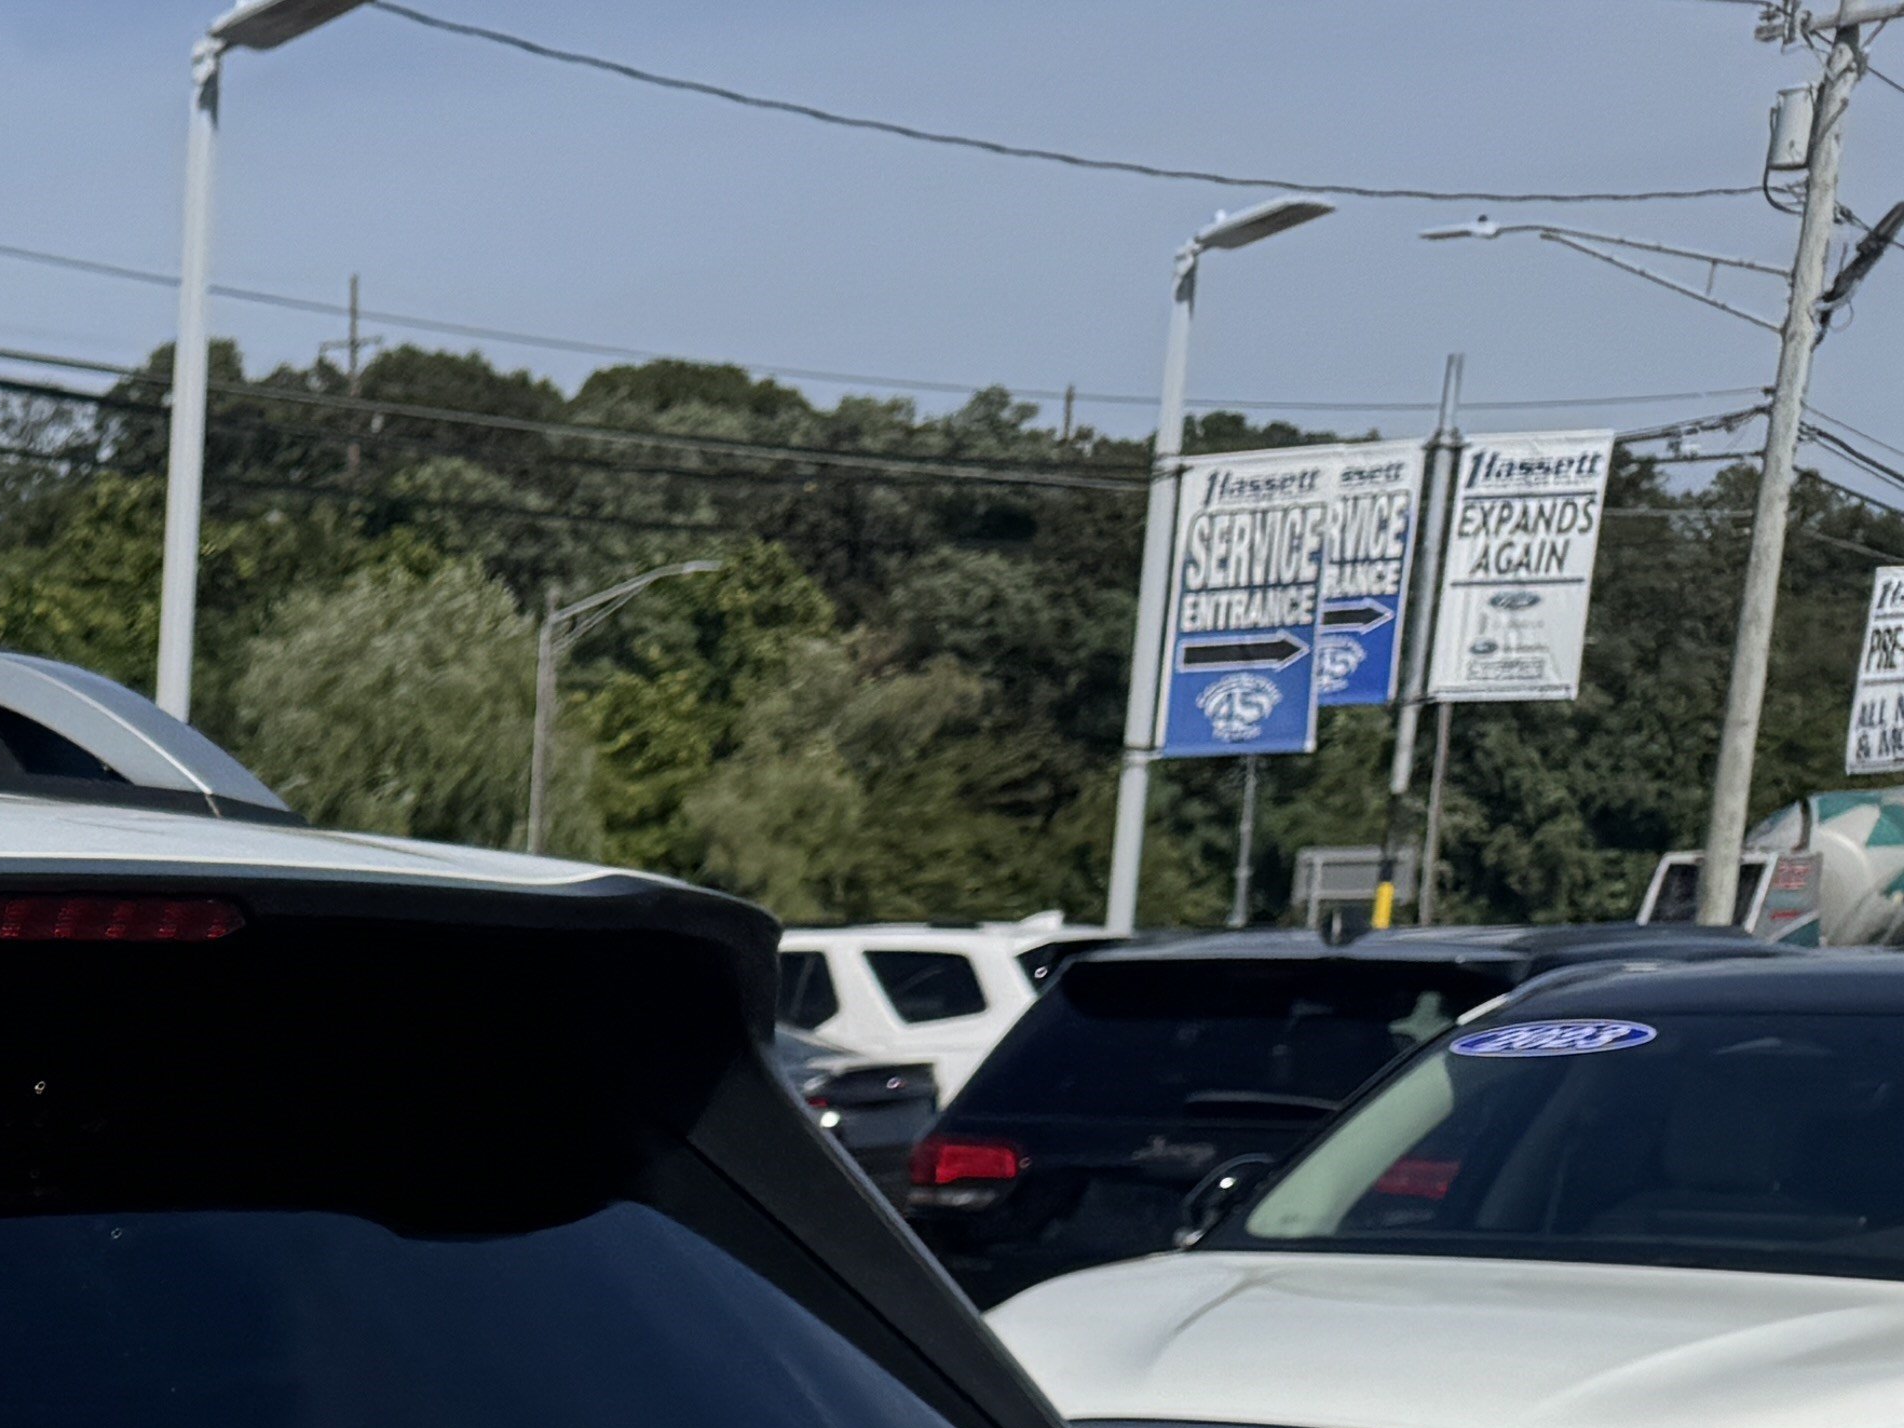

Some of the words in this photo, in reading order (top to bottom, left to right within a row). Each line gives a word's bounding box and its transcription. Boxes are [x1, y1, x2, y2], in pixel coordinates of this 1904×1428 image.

[1205, 467, 1321, 506] Hassett
[1341, 461, 1405, 483] ssett
[1464, 451, 1602, 489] Hassett
[1325, 492, 1409, 561] RVICE
[1457, 499, 1596, 538] EXPANDS
[1185, 503, 1323, 589] SERVICE
[1469, 538, 1570, 574] AGAIN
[1323, 560, 1400, 599] RANCE
[1180, 585, 1316, 632] ENTRANCE
